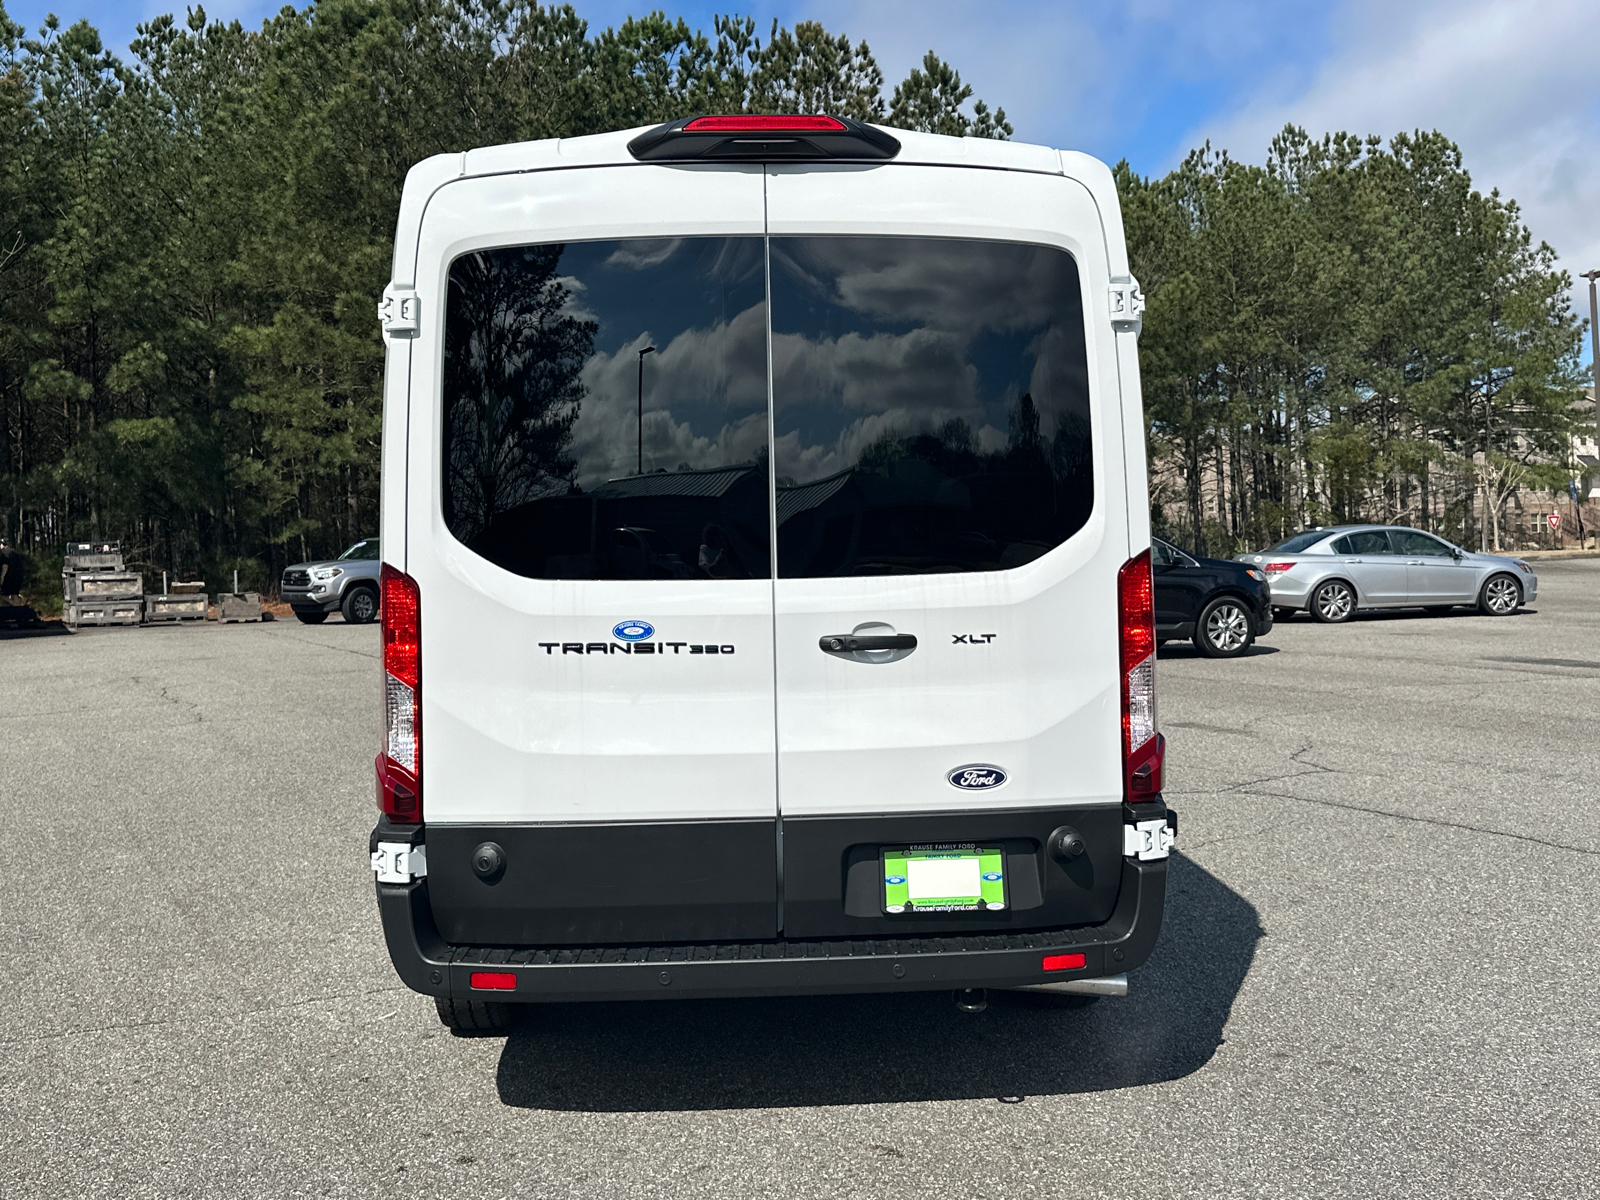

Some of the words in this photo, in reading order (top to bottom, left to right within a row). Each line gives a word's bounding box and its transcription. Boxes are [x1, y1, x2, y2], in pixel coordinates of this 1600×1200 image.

[951, 634, 997, 645] XLT
[538, 642, 687, 655] TRANSIT
[960, 770, 996, 786] Ford
